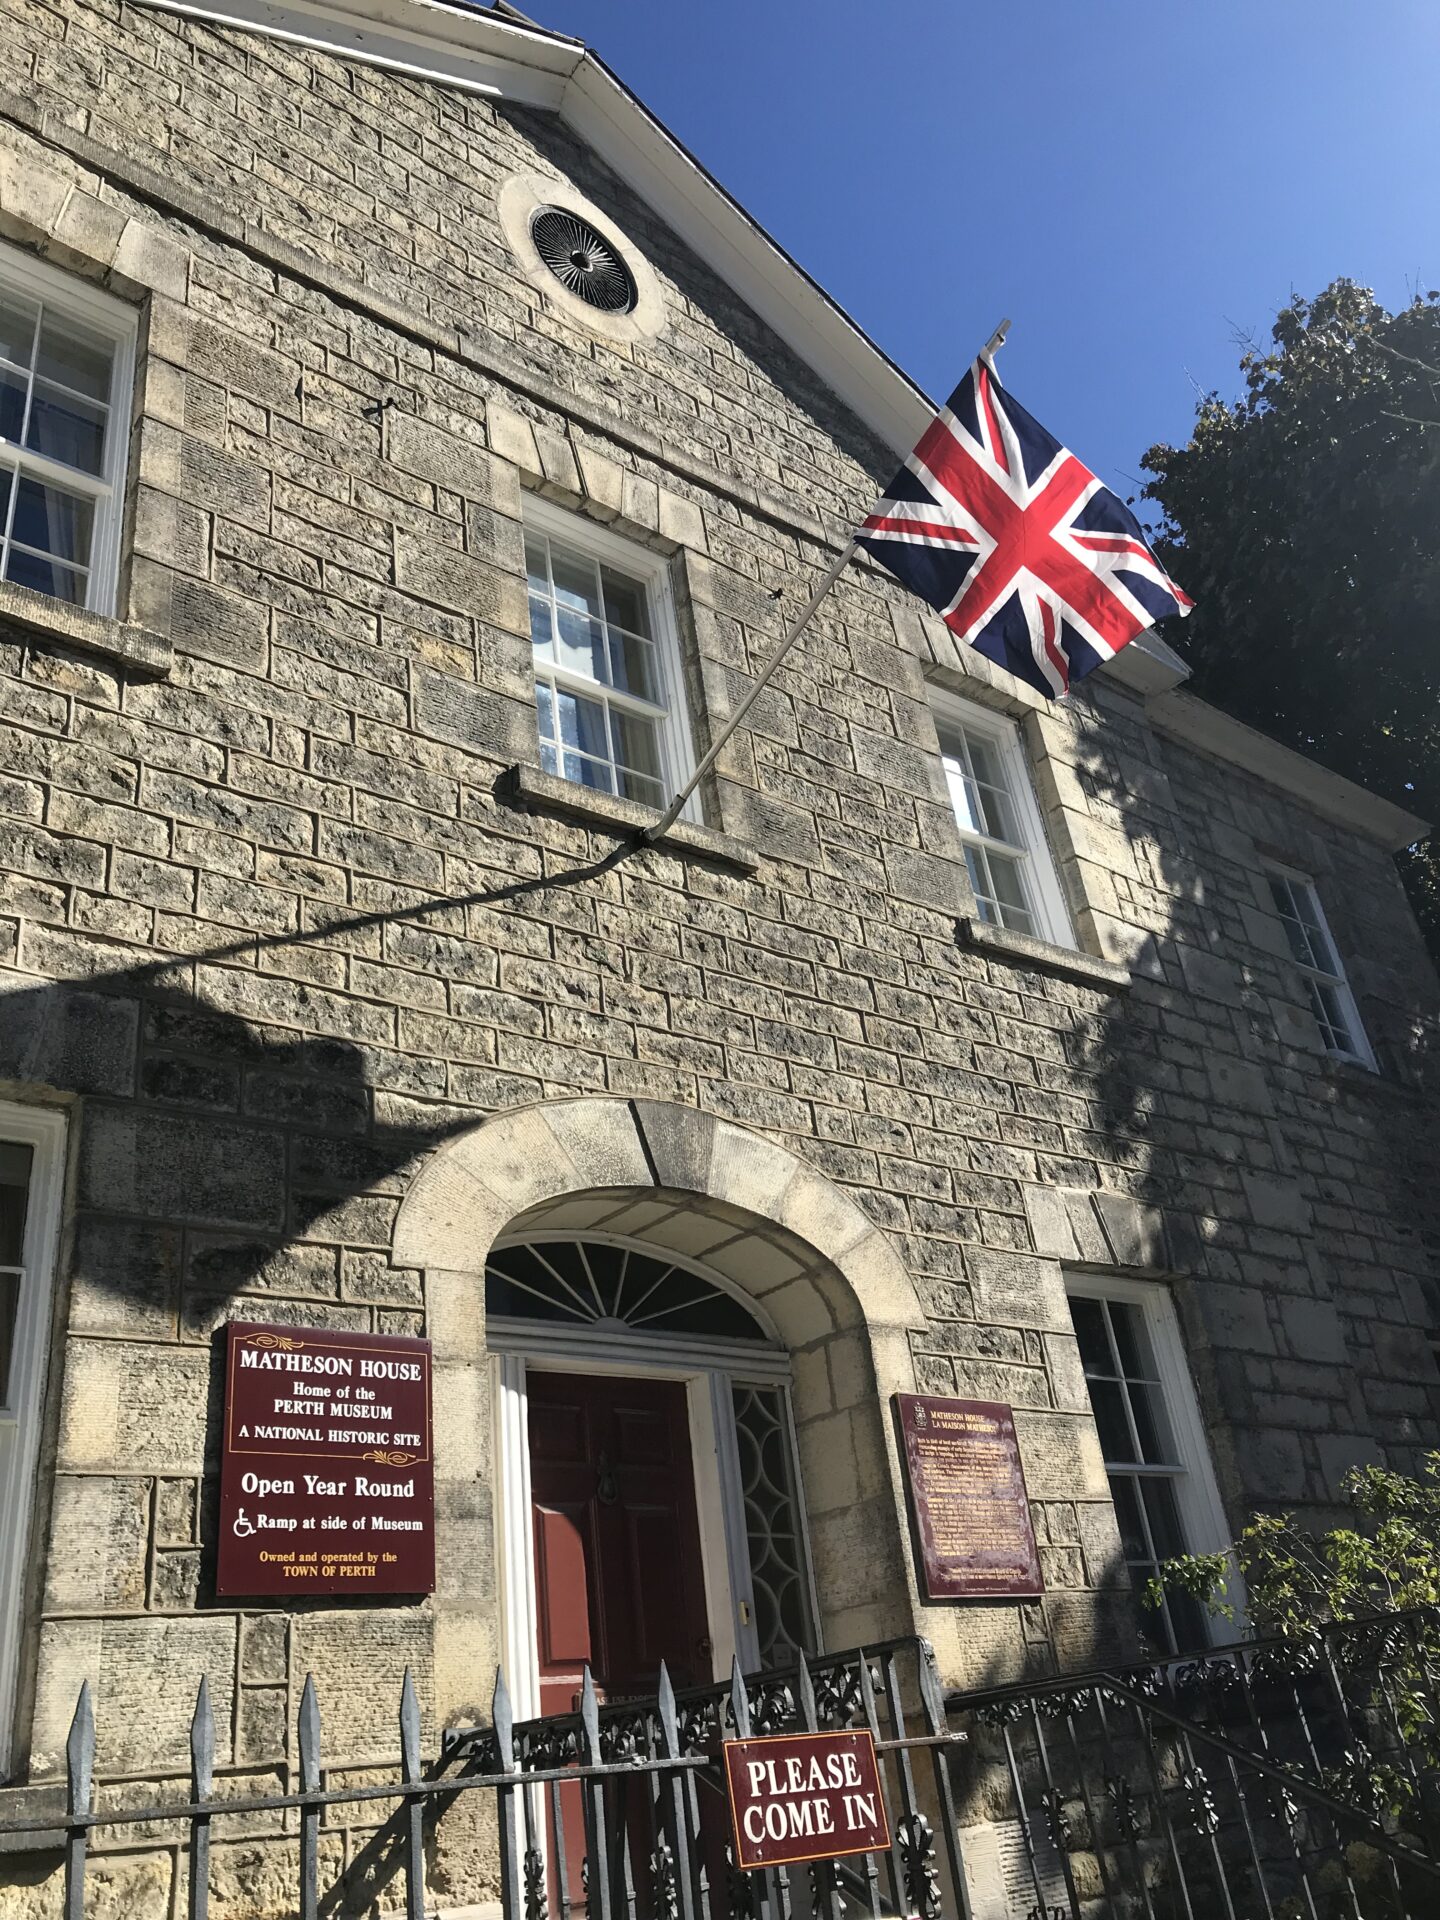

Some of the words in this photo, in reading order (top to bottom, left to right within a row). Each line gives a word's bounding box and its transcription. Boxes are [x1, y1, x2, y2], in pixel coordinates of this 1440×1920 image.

[240, 1350, 353, 1376] MATHESON
[360, 1360, 421, 1381] HOUSE
[293, 1382, 331, 1397] Home
[336, 1386, 350, 1398] of
[355, 1387, 375, 1400] the
[274, 1399, 324, 1415] PERTH
[330, 1403, 392, 1419] MUSEUM
[930, 1410, 964, 1421] MATHESON
[964, 1413, 985, 1423] HOUSE
[932, 1420, 940, 1428] LA
[941, 1421, 966, 1430] MAISON
[238, 1425, 249, 1437] A
[254, 1426, 323, 1441] NATIONAL
[328, 1430, 389, 1444] HISTORIC
[394, 1433, 421, 1446] SITE
[242, 1473, 295, 1497] Open
[303, 1475, 347, 1495] Year
[355, 1477, 414, 1497] Round
[257, 1514, 297, 1531] Ramp
[303, 1517, 315, 1529] at
[321, 1516, 347, 1529] side
[352, 1517, 366, 1529] of
[371, 1517, 423, 1530] Museum
[260, 1551, 295, 1562] Owned
[299, 1552, 317, 1561] and
[321, 1552, 363, 1563] operated
[368, 1552, 378, 1563] by
[383, 1552, 397, 1561] the
[283, 1566, 318, 1576] TOWN
[322, 1566, 336, 1576] OF
[340, 1566, 375, 1576] PERTH
[746, 1753, 862, 1797] PLEASE
[744, 1798, 834, 1843] COME
[842, 1793, 877, 1830] IN
